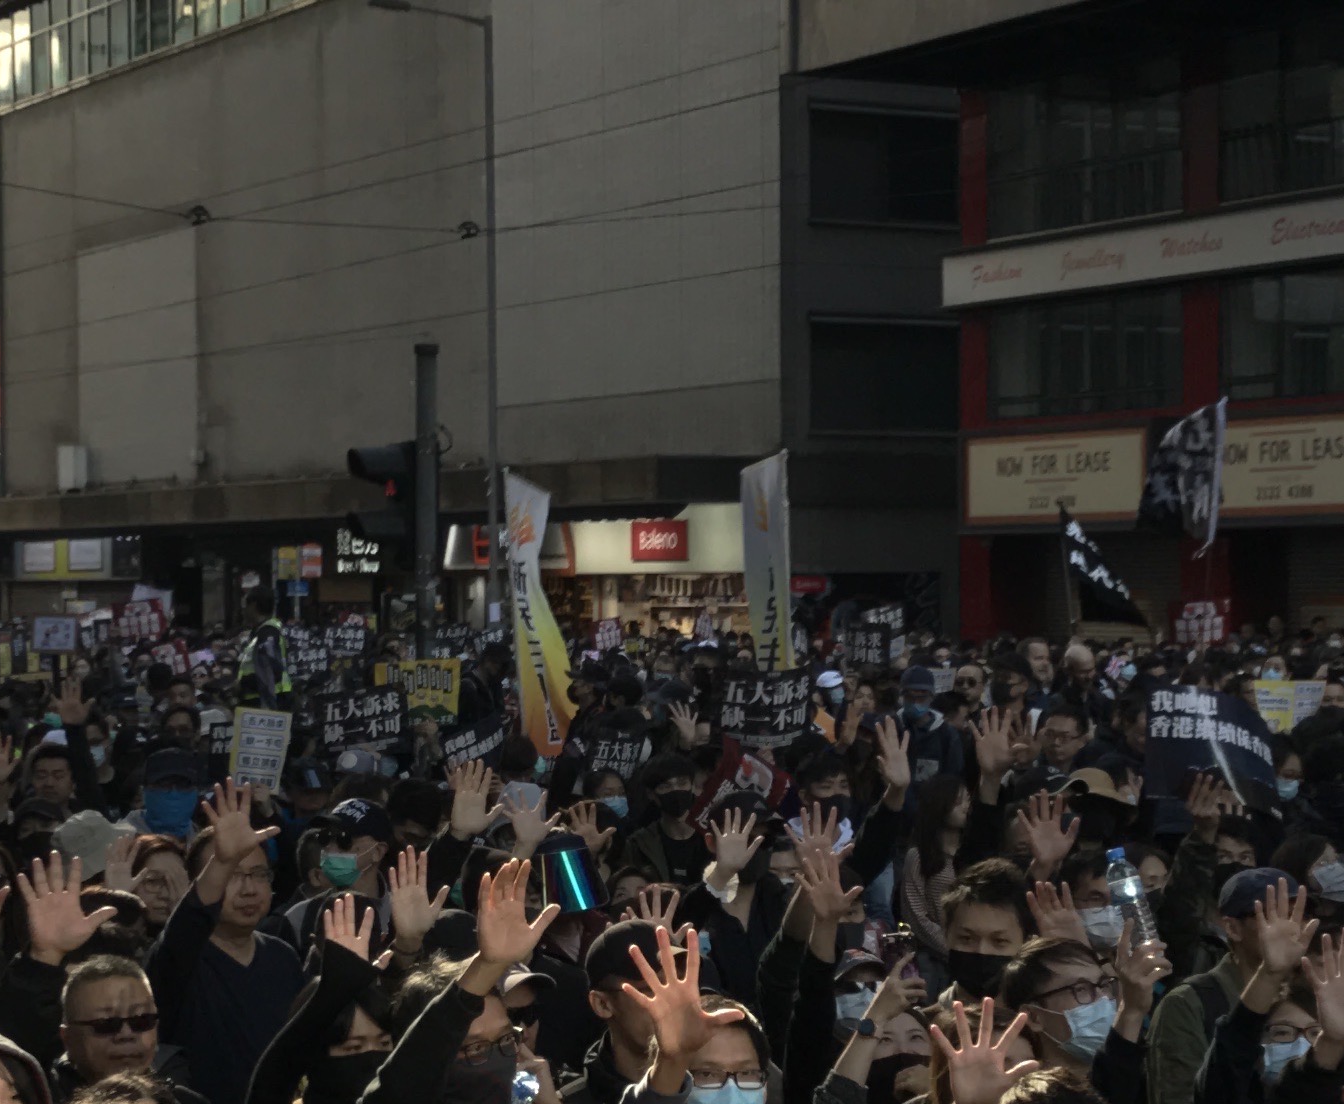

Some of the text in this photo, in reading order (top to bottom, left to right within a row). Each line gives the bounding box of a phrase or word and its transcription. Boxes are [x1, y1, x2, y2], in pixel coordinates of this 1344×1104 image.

[996, 450, 1111, 478] NOW FOR LEASE
[1260, 439, 1291, 463] FOR
[325, 691, 401, 723] 五大訴求
[324, 713, 402, 745] 缺一不可
